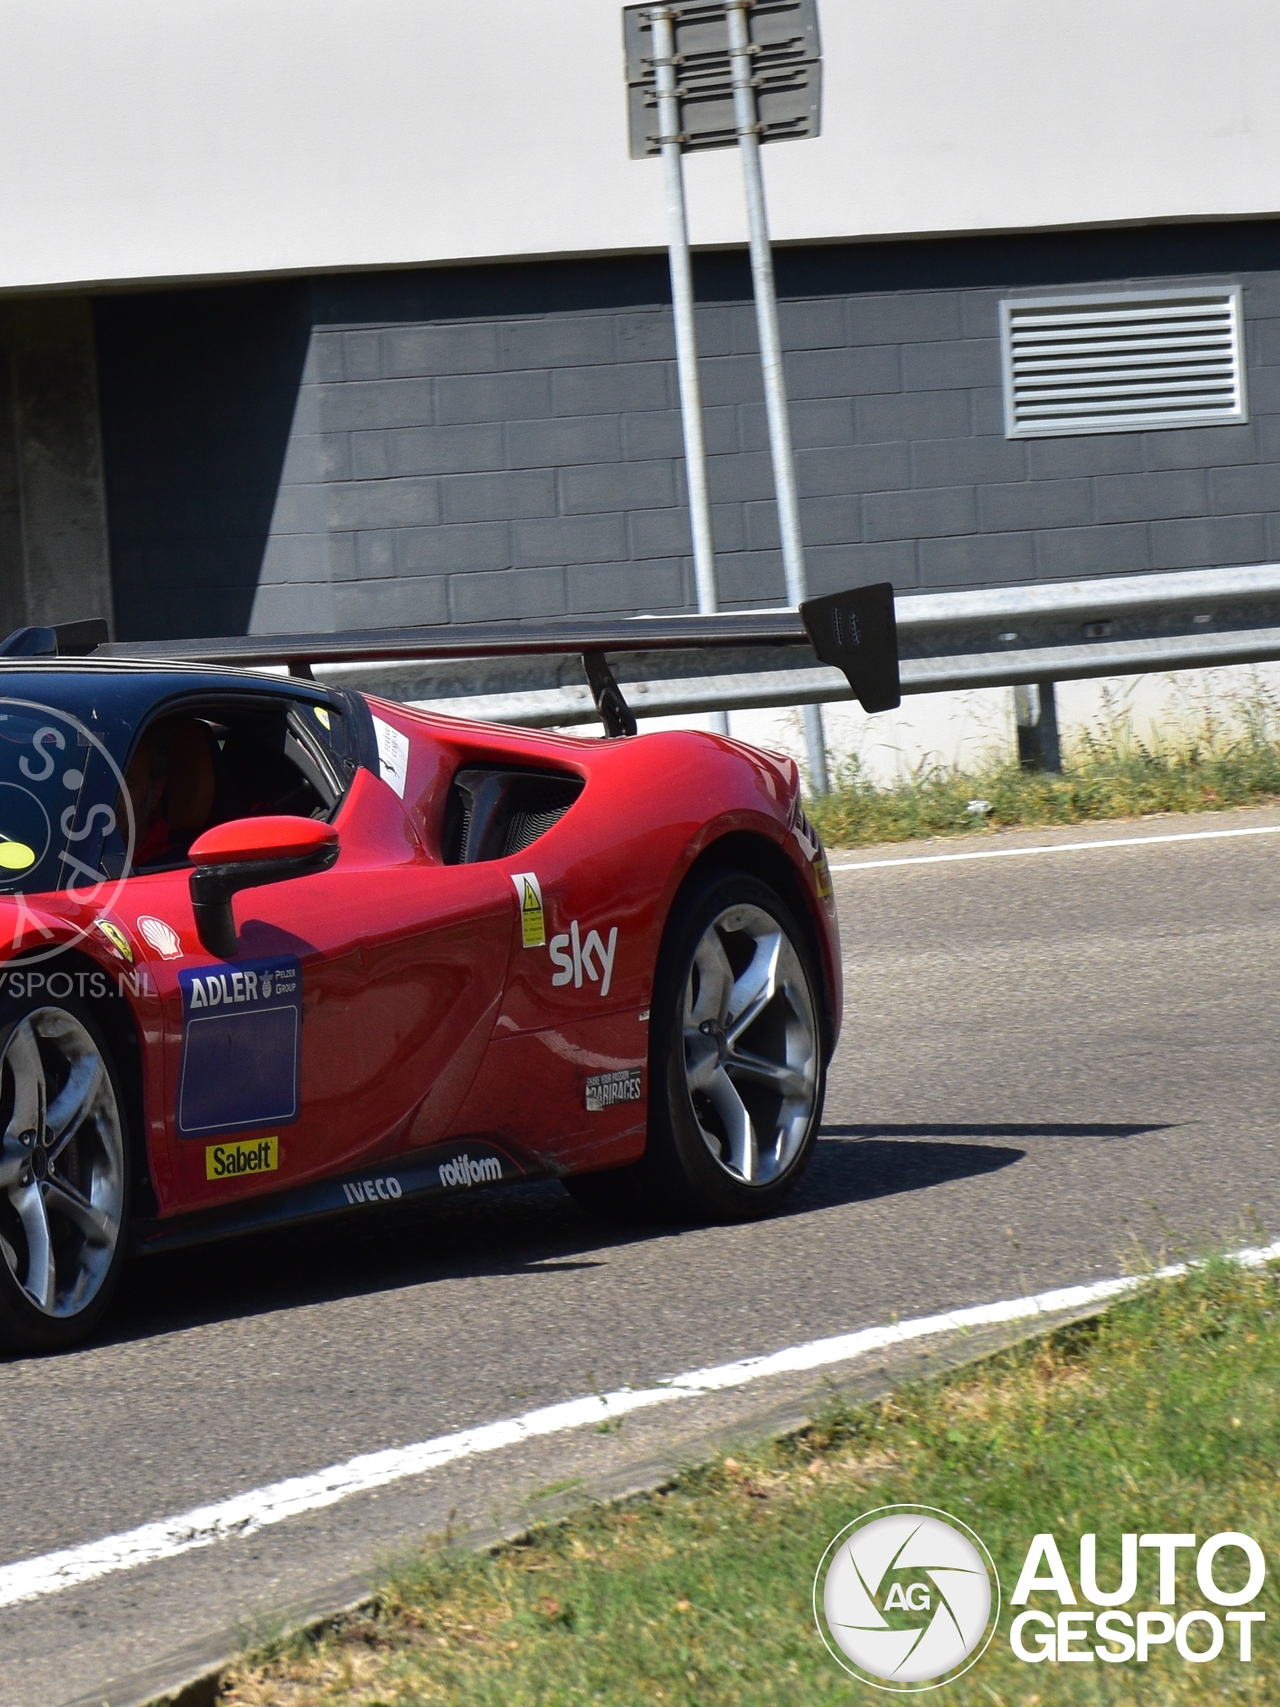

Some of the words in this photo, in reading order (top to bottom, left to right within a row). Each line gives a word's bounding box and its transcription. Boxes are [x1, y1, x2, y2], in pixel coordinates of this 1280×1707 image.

[549, 920, 618, 996] sky
[190, 971, 258, 1009] ADLER
[213, 1140, 271, 1177] Sabelt
[439, 1153, 504, 1188] rotiform
[343, 1177, 403, 1204] IVECO
